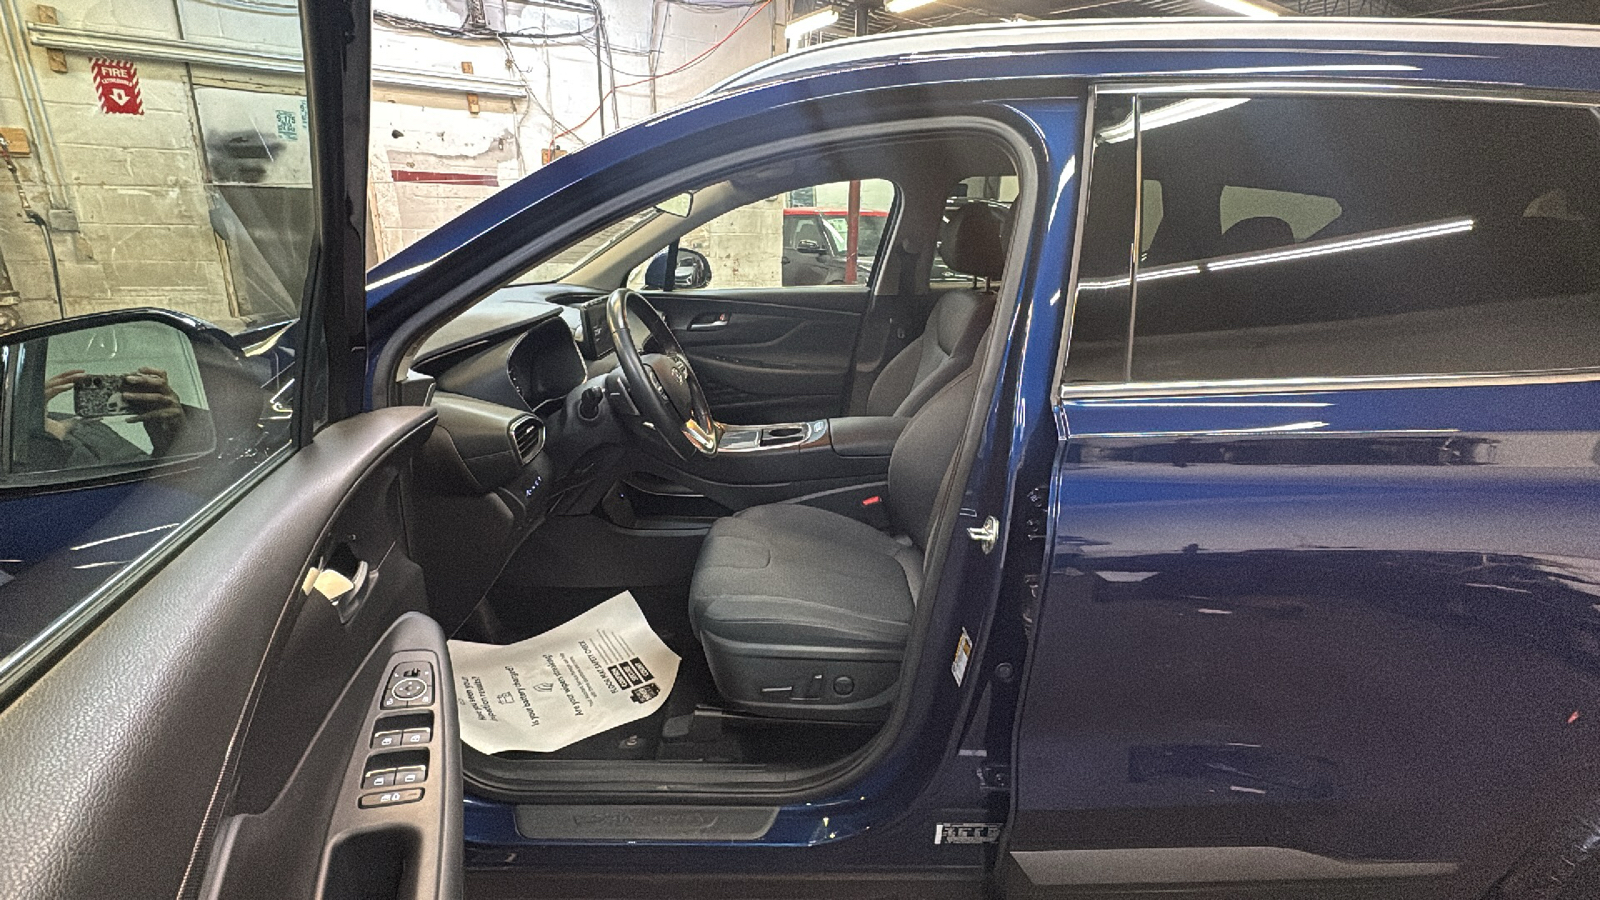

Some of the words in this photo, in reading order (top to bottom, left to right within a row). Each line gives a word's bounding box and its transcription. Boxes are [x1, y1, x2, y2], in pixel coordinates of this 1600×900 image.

[101, 66, 129, 78] FIRE
[577, 639, 592, 654] CHECK
[587, 654, 601, 669] SAFETY
[595, 668, 608, 679] MAT
[460, 676, 473, 689] your
[557, 676, 570, 693] wipers
[602, 677, 619, 694] FLOOR
[465, 689, 475, 702] seen
[517, 688, 530, 708] battery
[565, 693, 580, 705] your
[525, 707, 539, 720] your
[572, 704, 584, 716] Are
[531, 719, 539, 727] Is
